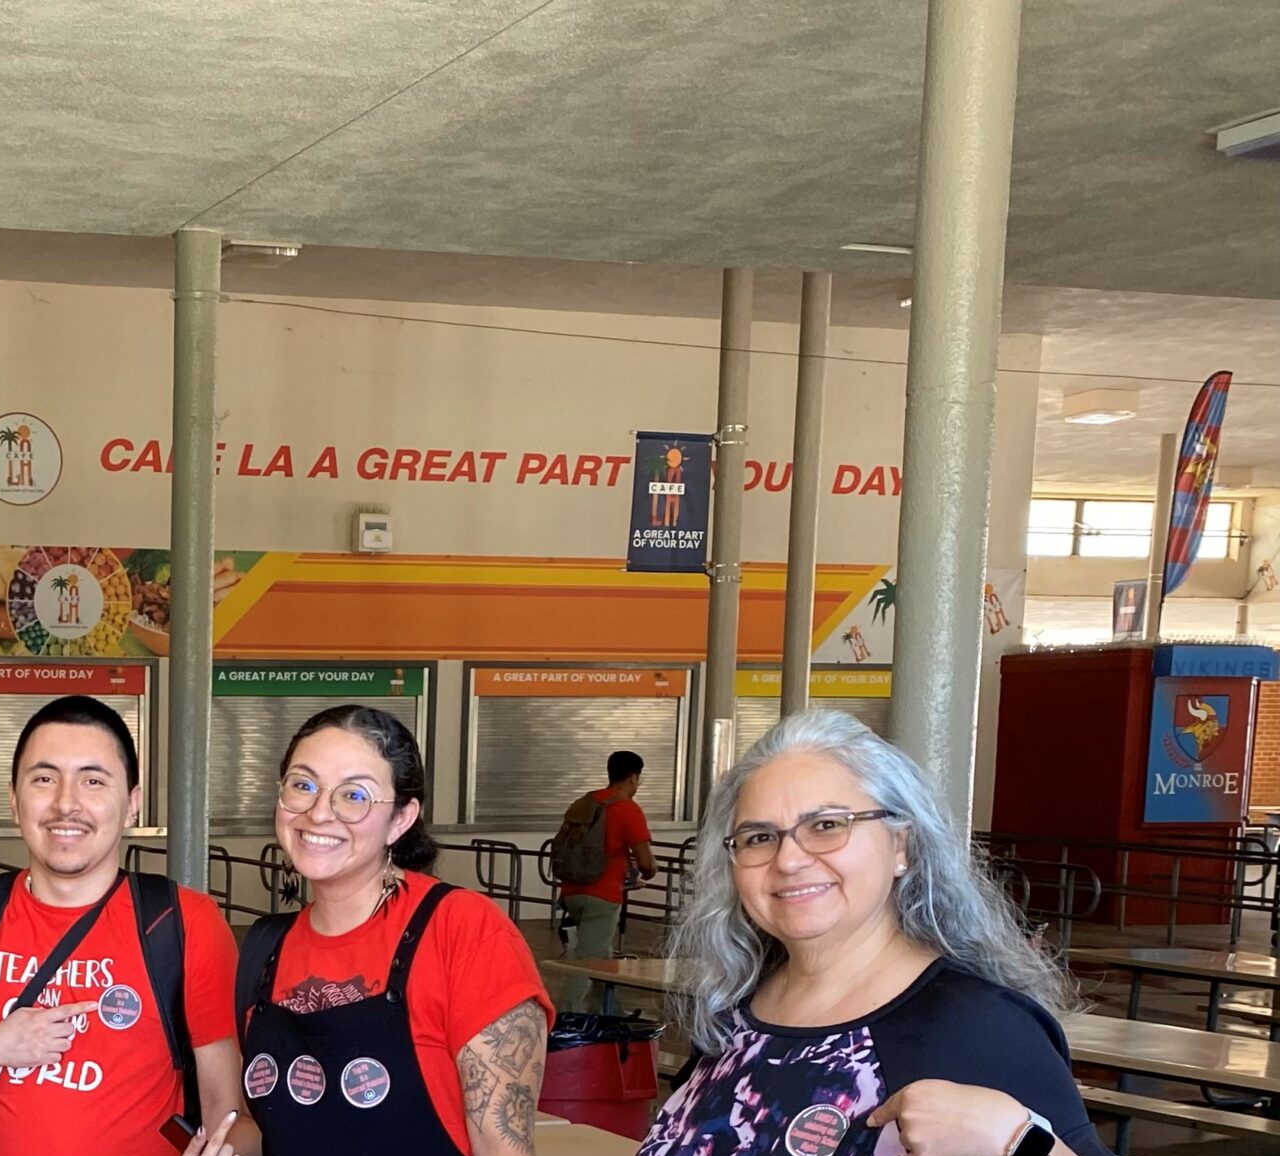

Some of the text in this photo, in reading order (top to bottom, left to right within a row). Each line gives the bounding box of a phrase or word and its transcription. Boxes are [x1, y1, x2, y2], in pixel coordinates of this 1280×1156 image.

[6, 452, 34, 460] CAFE
[237, 443, 294, 478] LA
[307, 446, 339, 479] A
[356, 447, 508, 483] GREAT
[516, 453, 632, 487] PART
[651, 483, 684, 494] CAFE
[633, 530, 704, 541] A GREAT PART
[633, 538, 701, 549] OF YOUR DAY
[15, 668, 30, 679] OF
[33, 668, 66, 679] YOUR
[69, 669, 94, 680] DAY
[1173, 661, 1271, 677] VIKINGS
[218, 672, 375, 681] A GREAT PART OF YOUR DAY
[493, 673, 641, 683] A GREAT PART OF YOUR DAY
[752, 675, 759, 683] A
[824, 674, 838, 684] OF
[841, 674, 867, 685] YOUR
[869, 675, 890, 685] DAY
